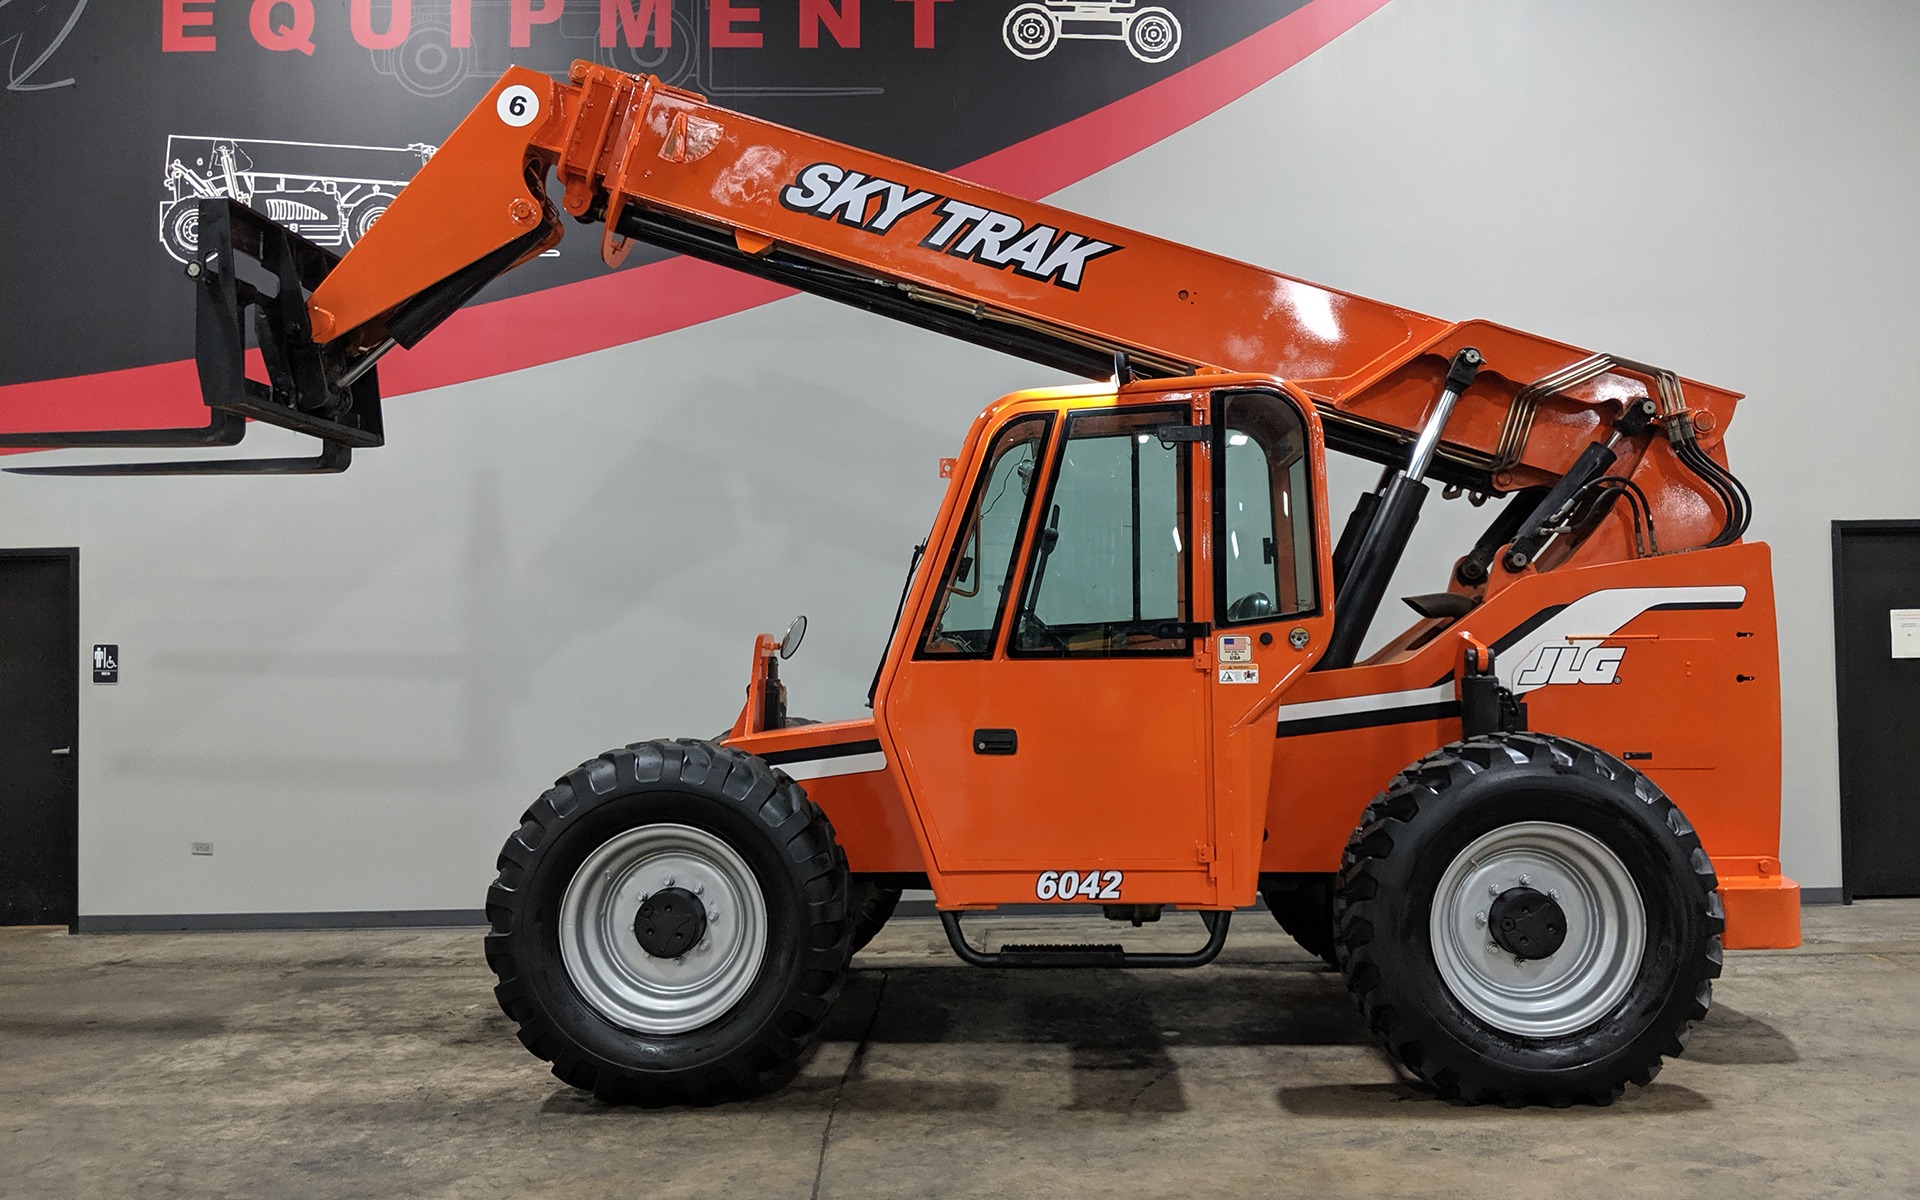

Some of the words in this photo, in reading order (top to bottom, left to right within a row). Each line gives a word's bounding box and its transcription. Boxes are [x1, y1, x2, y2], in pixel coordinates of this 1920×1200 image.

[162, 0, 953, 56] EQUIPMENT
[509, 95, 528, 117] 6
[781, 163, 939, 235] SKY
[920, 198, 1123, 291] TRAK
[1036, 870, 1123, 900] 6042
